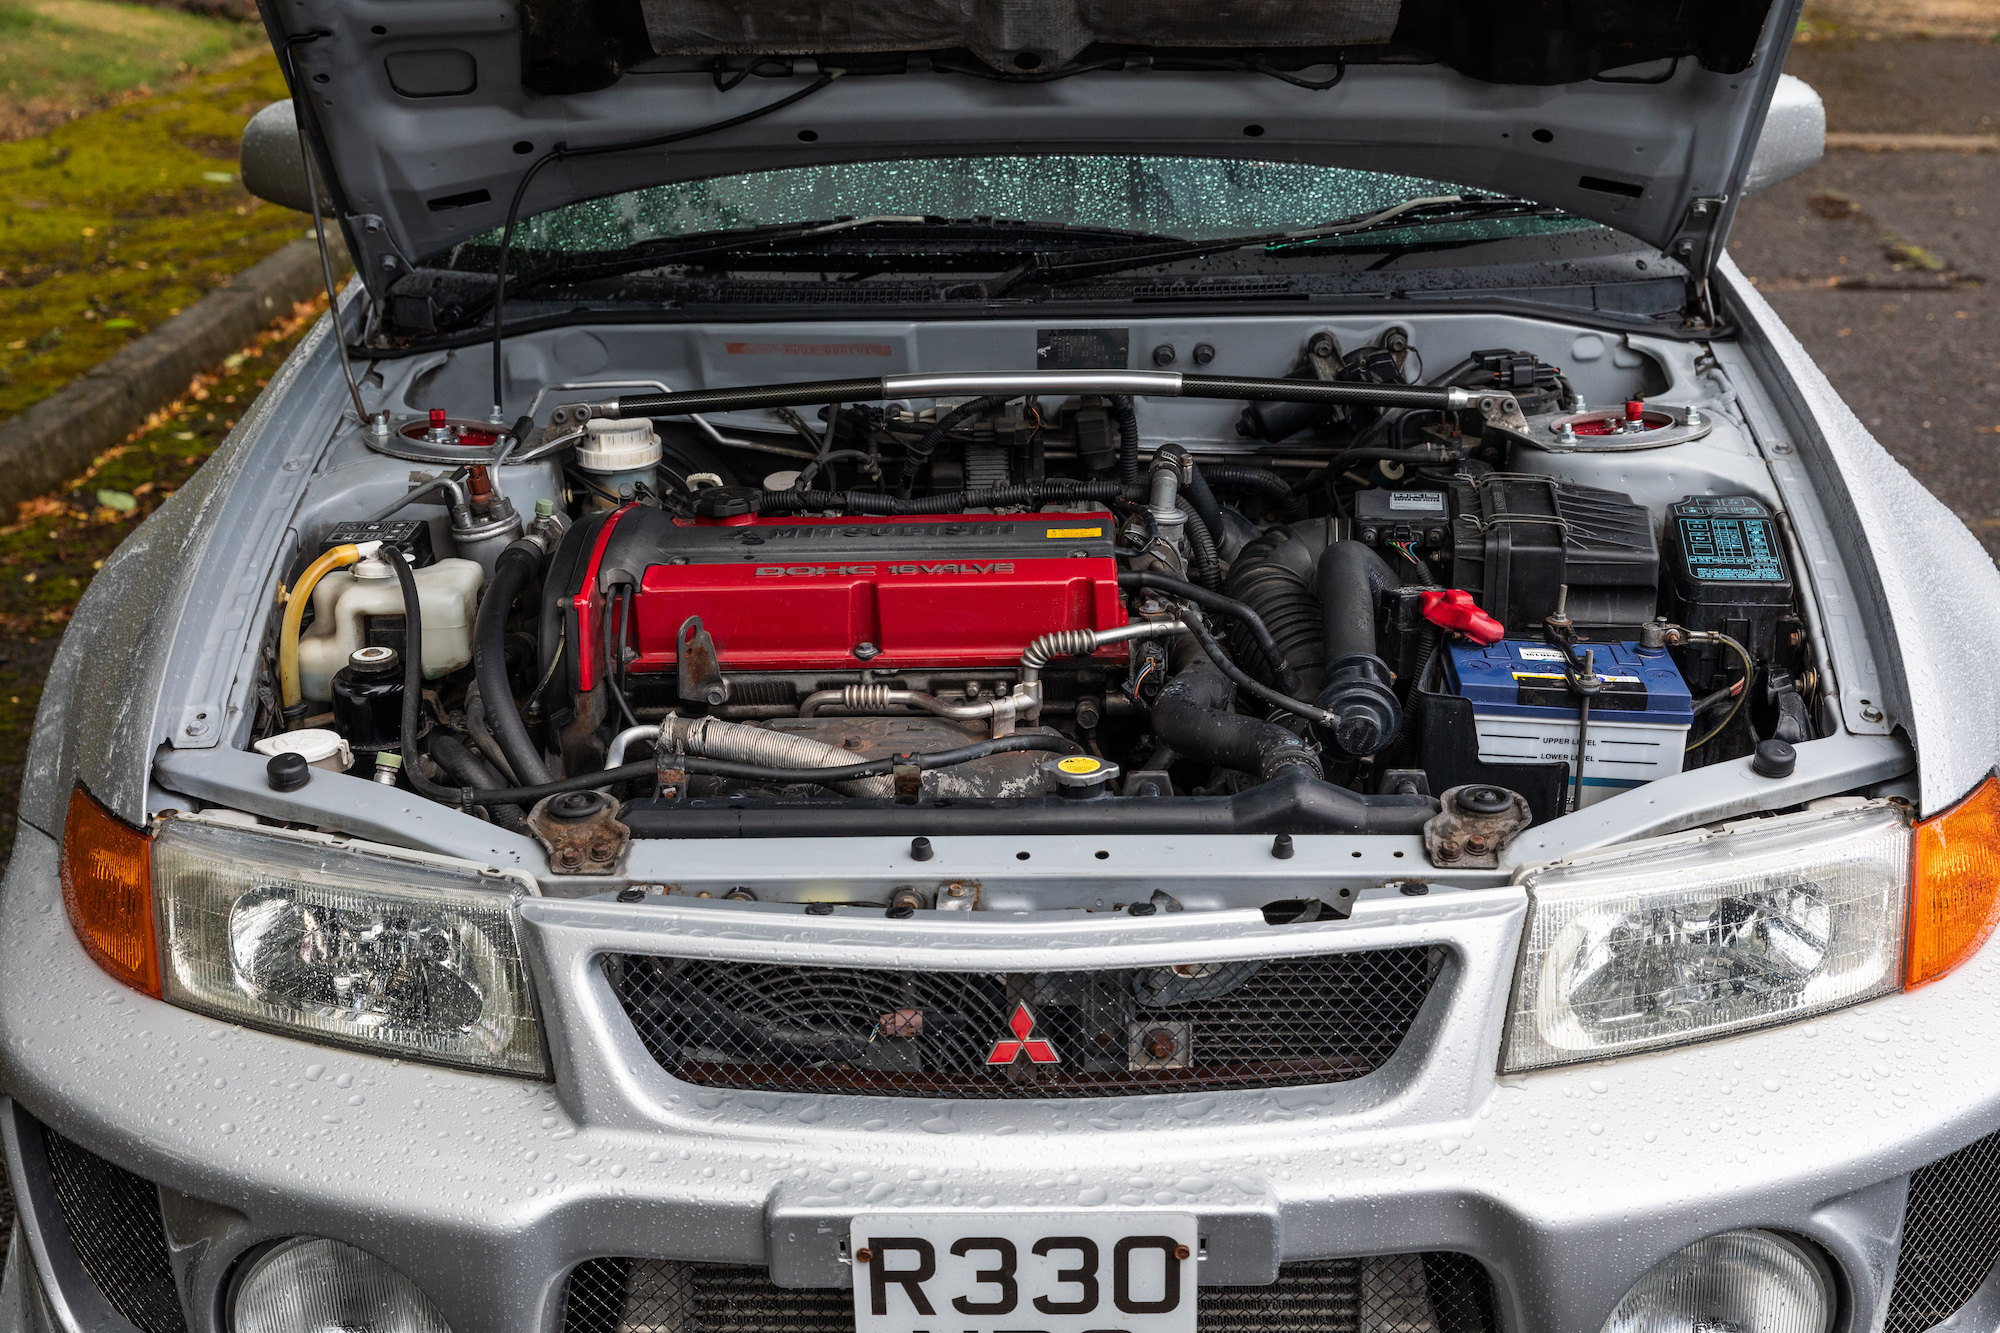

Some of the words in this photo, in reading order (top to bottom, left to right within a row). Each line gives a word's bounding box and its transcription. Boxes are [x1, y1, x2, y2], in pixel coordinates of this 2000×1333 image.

[770, 524, 1016, 540] MITSUBISHI
[755, 565, 877, 577] DOHC
[1542, 737, 1570, 745] UPPER
[1541, 753, 1569, 761] LOWER
[867, 1236, 1181, 1316] R330
